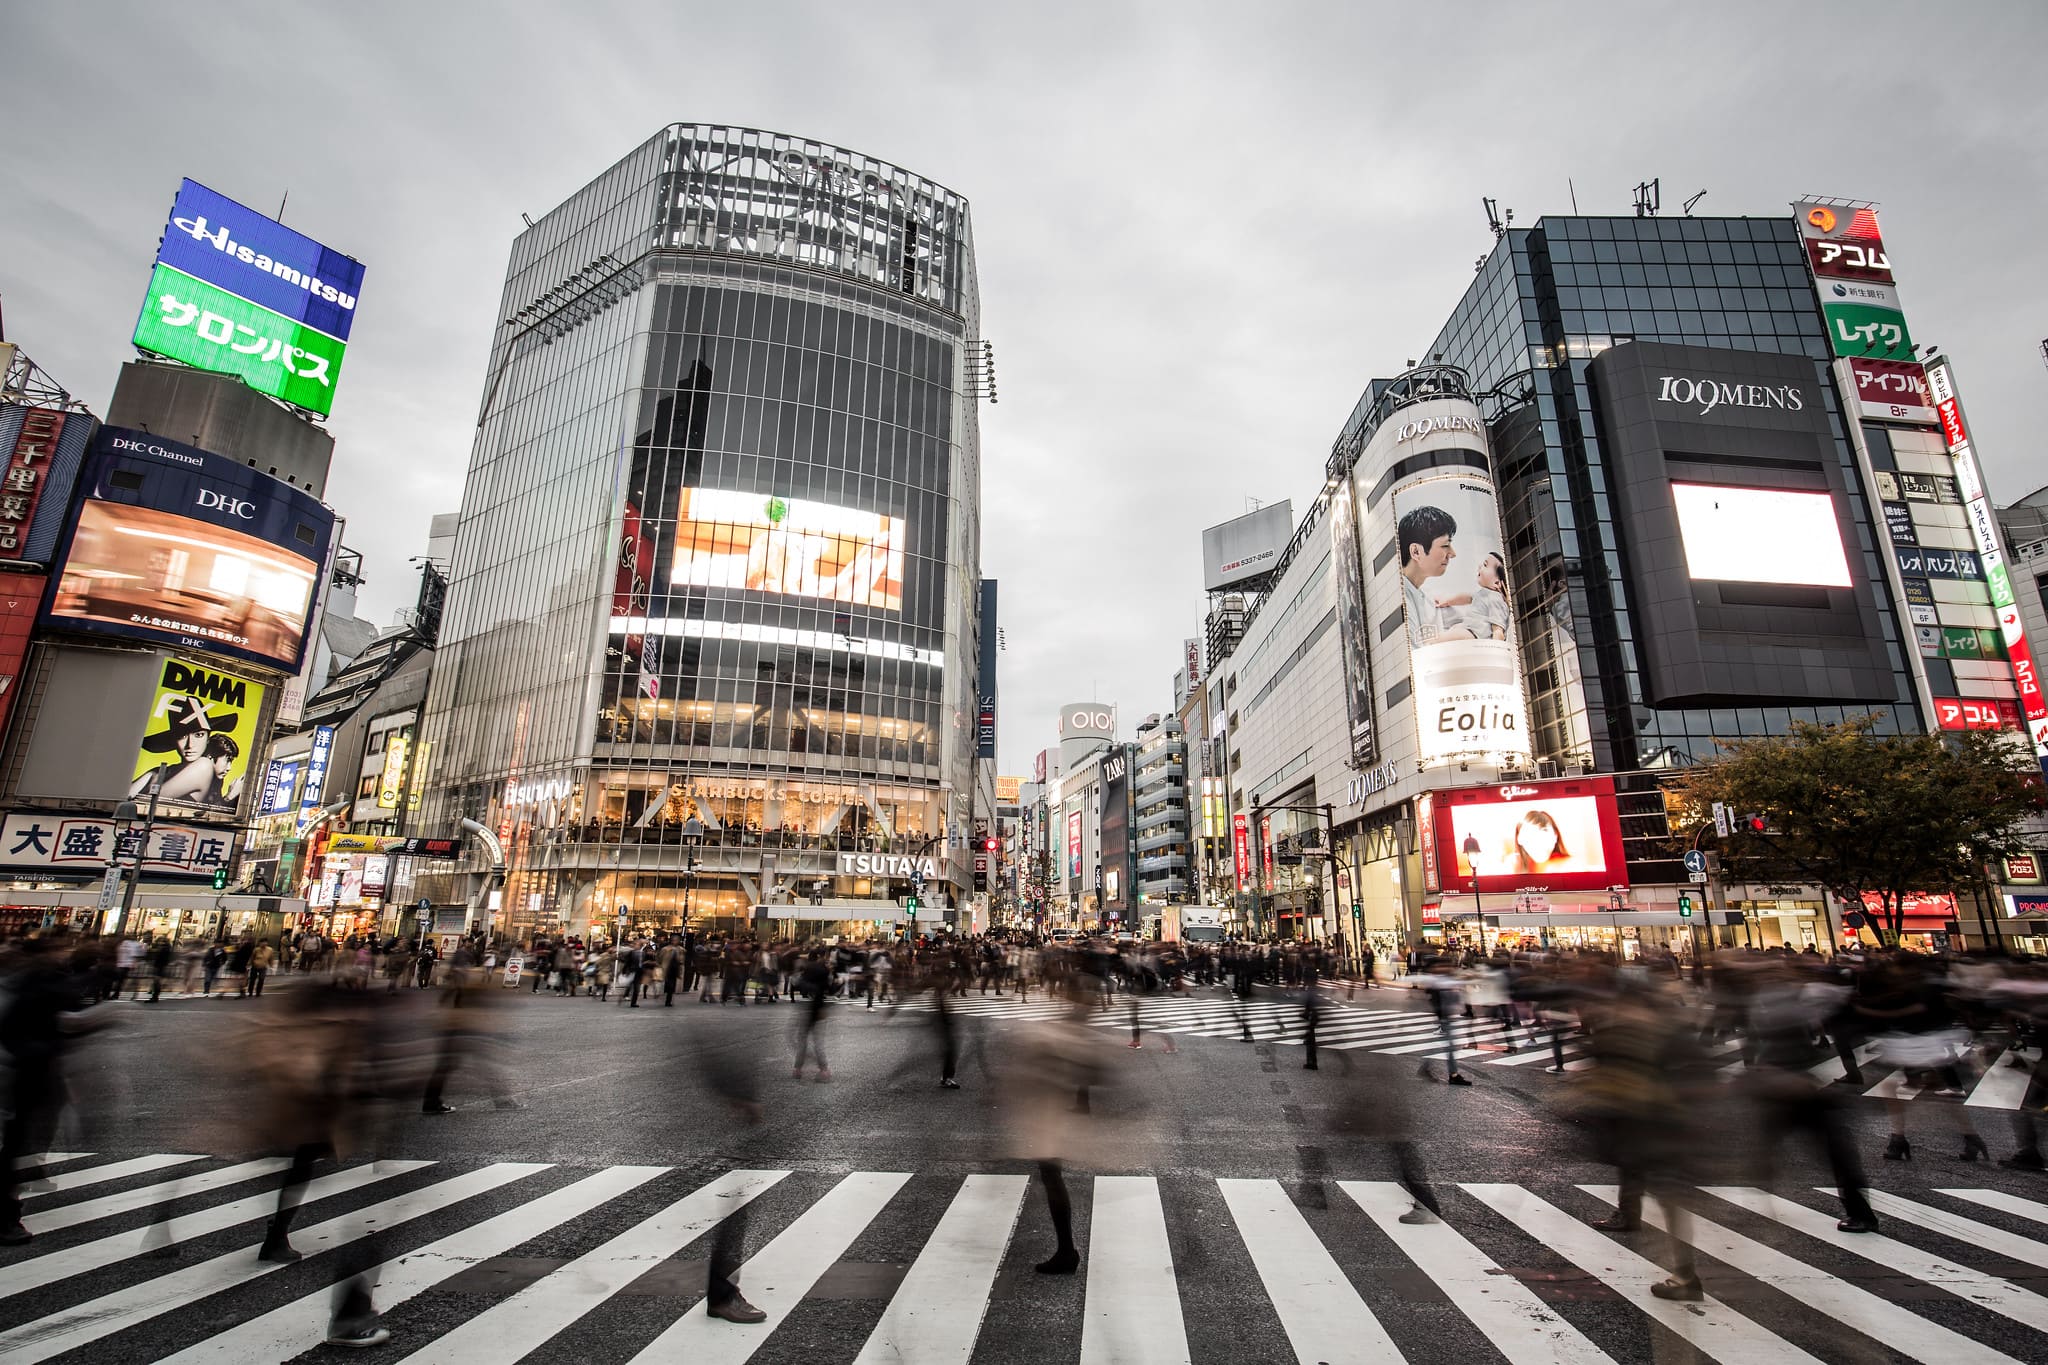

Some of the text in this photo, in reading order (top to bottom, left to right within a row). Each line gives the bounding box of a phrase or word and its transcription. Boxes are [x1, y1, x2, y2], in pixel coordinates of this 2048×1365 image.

[173, 216, 356, 310] Hisamitsu
[1817, 242, 1890, 269] アコム
[1849, 287, 1885, 300] 新生銀行
[160, 294, 331, 386] サロンパス
[1836, 318, 1902, 346] レイク
[1855, 370, 1926, 394] アイフル
[1890, 406, 1908, 417] 8F
[1945, 409, 1963, 443] アイフル
[112, 438, 203, 466] DHC Channel
[196, 488, 256, 519] DHC
[1460, 484, 1493, 496] Panasonic
[1900, 555, 1977, 574] レオパレス21
[1991, 572, 2009, 601] レイク
[181, 637, 205, 648] DHC
[1945, 636, 1978, 650] レイク
[1187, 642, 1200, 683] 大和証券
[162, 661, 246, 709] DMM
[2015, 660, 2037, 694] アコム
[154, 693, 216, 730] FX
[980, 696, 994, 745] SEIBU
[1437, 705, 1516, 733] Eolia
[1942, 705, 1999, 723] アコム
[303, 730, 331, 802] 洋服の青山
[1103, 755, 1125, 783] ZARA
[671, 782, 864, 807] STARBUCKS COFFEE
[10, 824, 225, 867] 大盛堂書店
[842, 853, 935, 877] TSUTAYA
[2010, 864, 2034, 874] プロミス
